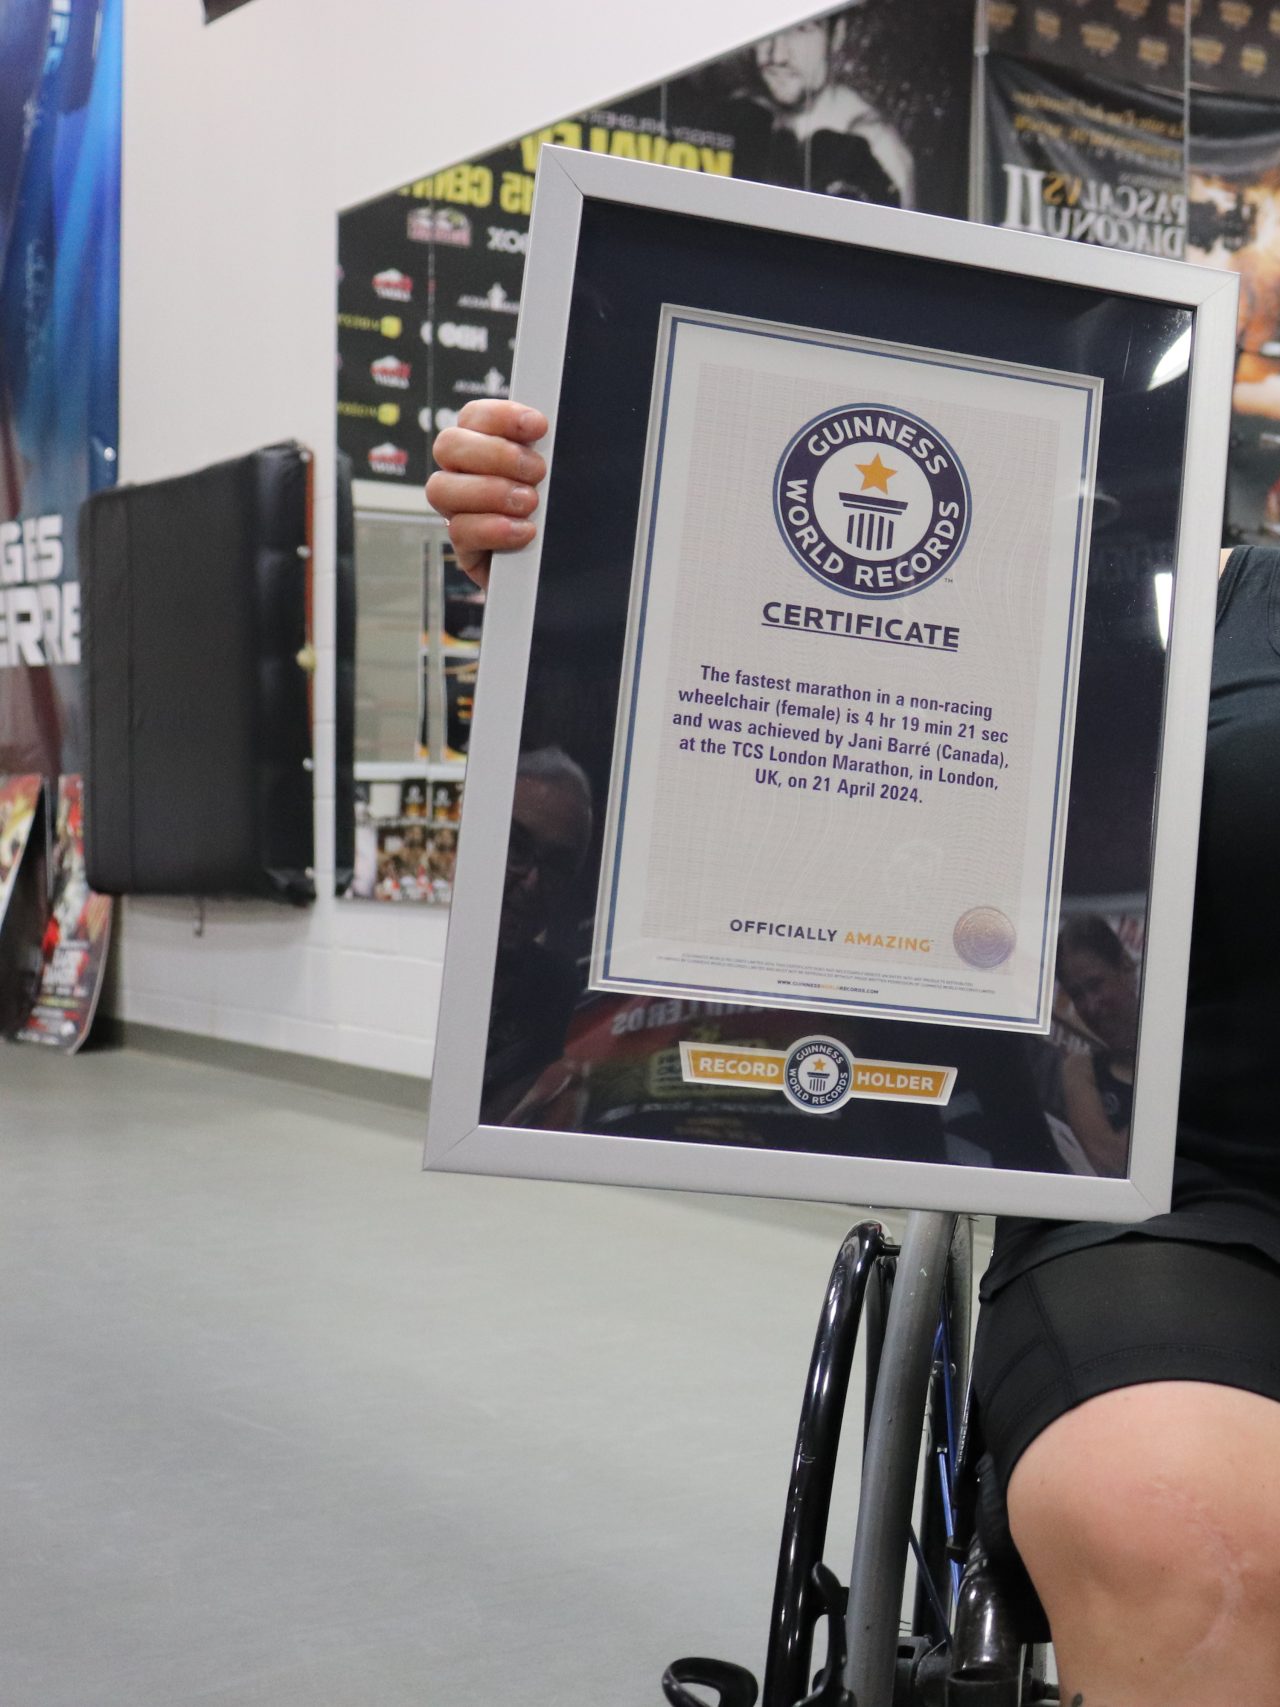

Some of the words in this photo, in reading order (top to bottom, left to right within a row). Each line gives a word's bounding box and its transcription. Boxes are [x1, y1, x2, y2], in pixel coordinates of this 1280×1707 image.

[808, 416, 948, 475] GUINNESS
[785, 479, 844, 575] WORLD
[855, 501, 960, 588] RECORDS
[762, 602, 960, 649] CERTIFICATE
[678, 688, 770, 712] wheelchair
[775, 699, 841, 725] (female)
[846, 708, 859, 724] is
[865, 711, 874, 726] 4
[879, 713, 896, 729] hr
[902, 716, 920, 732] 19
[925, 720, 953, 736] min
[958, 723, 975, 739] 21
[981, 729, 1009, 744] sec
[701, 665, 730, 683] The
[735, 670, 791, 692] fastest
[796, 682, 871, 703] marathon
[876, 689, 890, 704] in
[896, 695, 905, 706] a
[910, 696, 993, 721] non-racing
[673, 713, 703, 728] and
[708, 718, 742, 733] was
[748, 722, 820, 743] achieved
[825, 730, 844, 749] by
[848, 733, 882, 751] Jani
[887, 737, 931, 757] Barré
[936, 744, 1009, 769] (Canada),
[679, 737, 695, 751] at
[701, 738, 726, 755] the
[732, 741, 764, 759] TCS
[769, 746, 827, 768] London
[832, 754, 914, 780] Marathon,
[919, 765, 933, 781] in
[938, 768, 998, 790] London,
[755, 768, 782, 788] UK,
[788, 776, 807, 789] on
[813, 776, 830, 792] 21
[837, 778, 875, 799] April
[880, 784, 923, 804] 2024.
[730, 919, 838, 942] OFFICIALLY
[844, 930, 931, 952] AMAZING
[700, 1056, 779, 1078] RECORD
[857, 1071, 934, 1092] HOLDER
[796, 1045, 844, 1065] GUINNESS
[789, 1068, 810, 1101] WORLD
[812, 1071, 848, 1105] RECORDS
